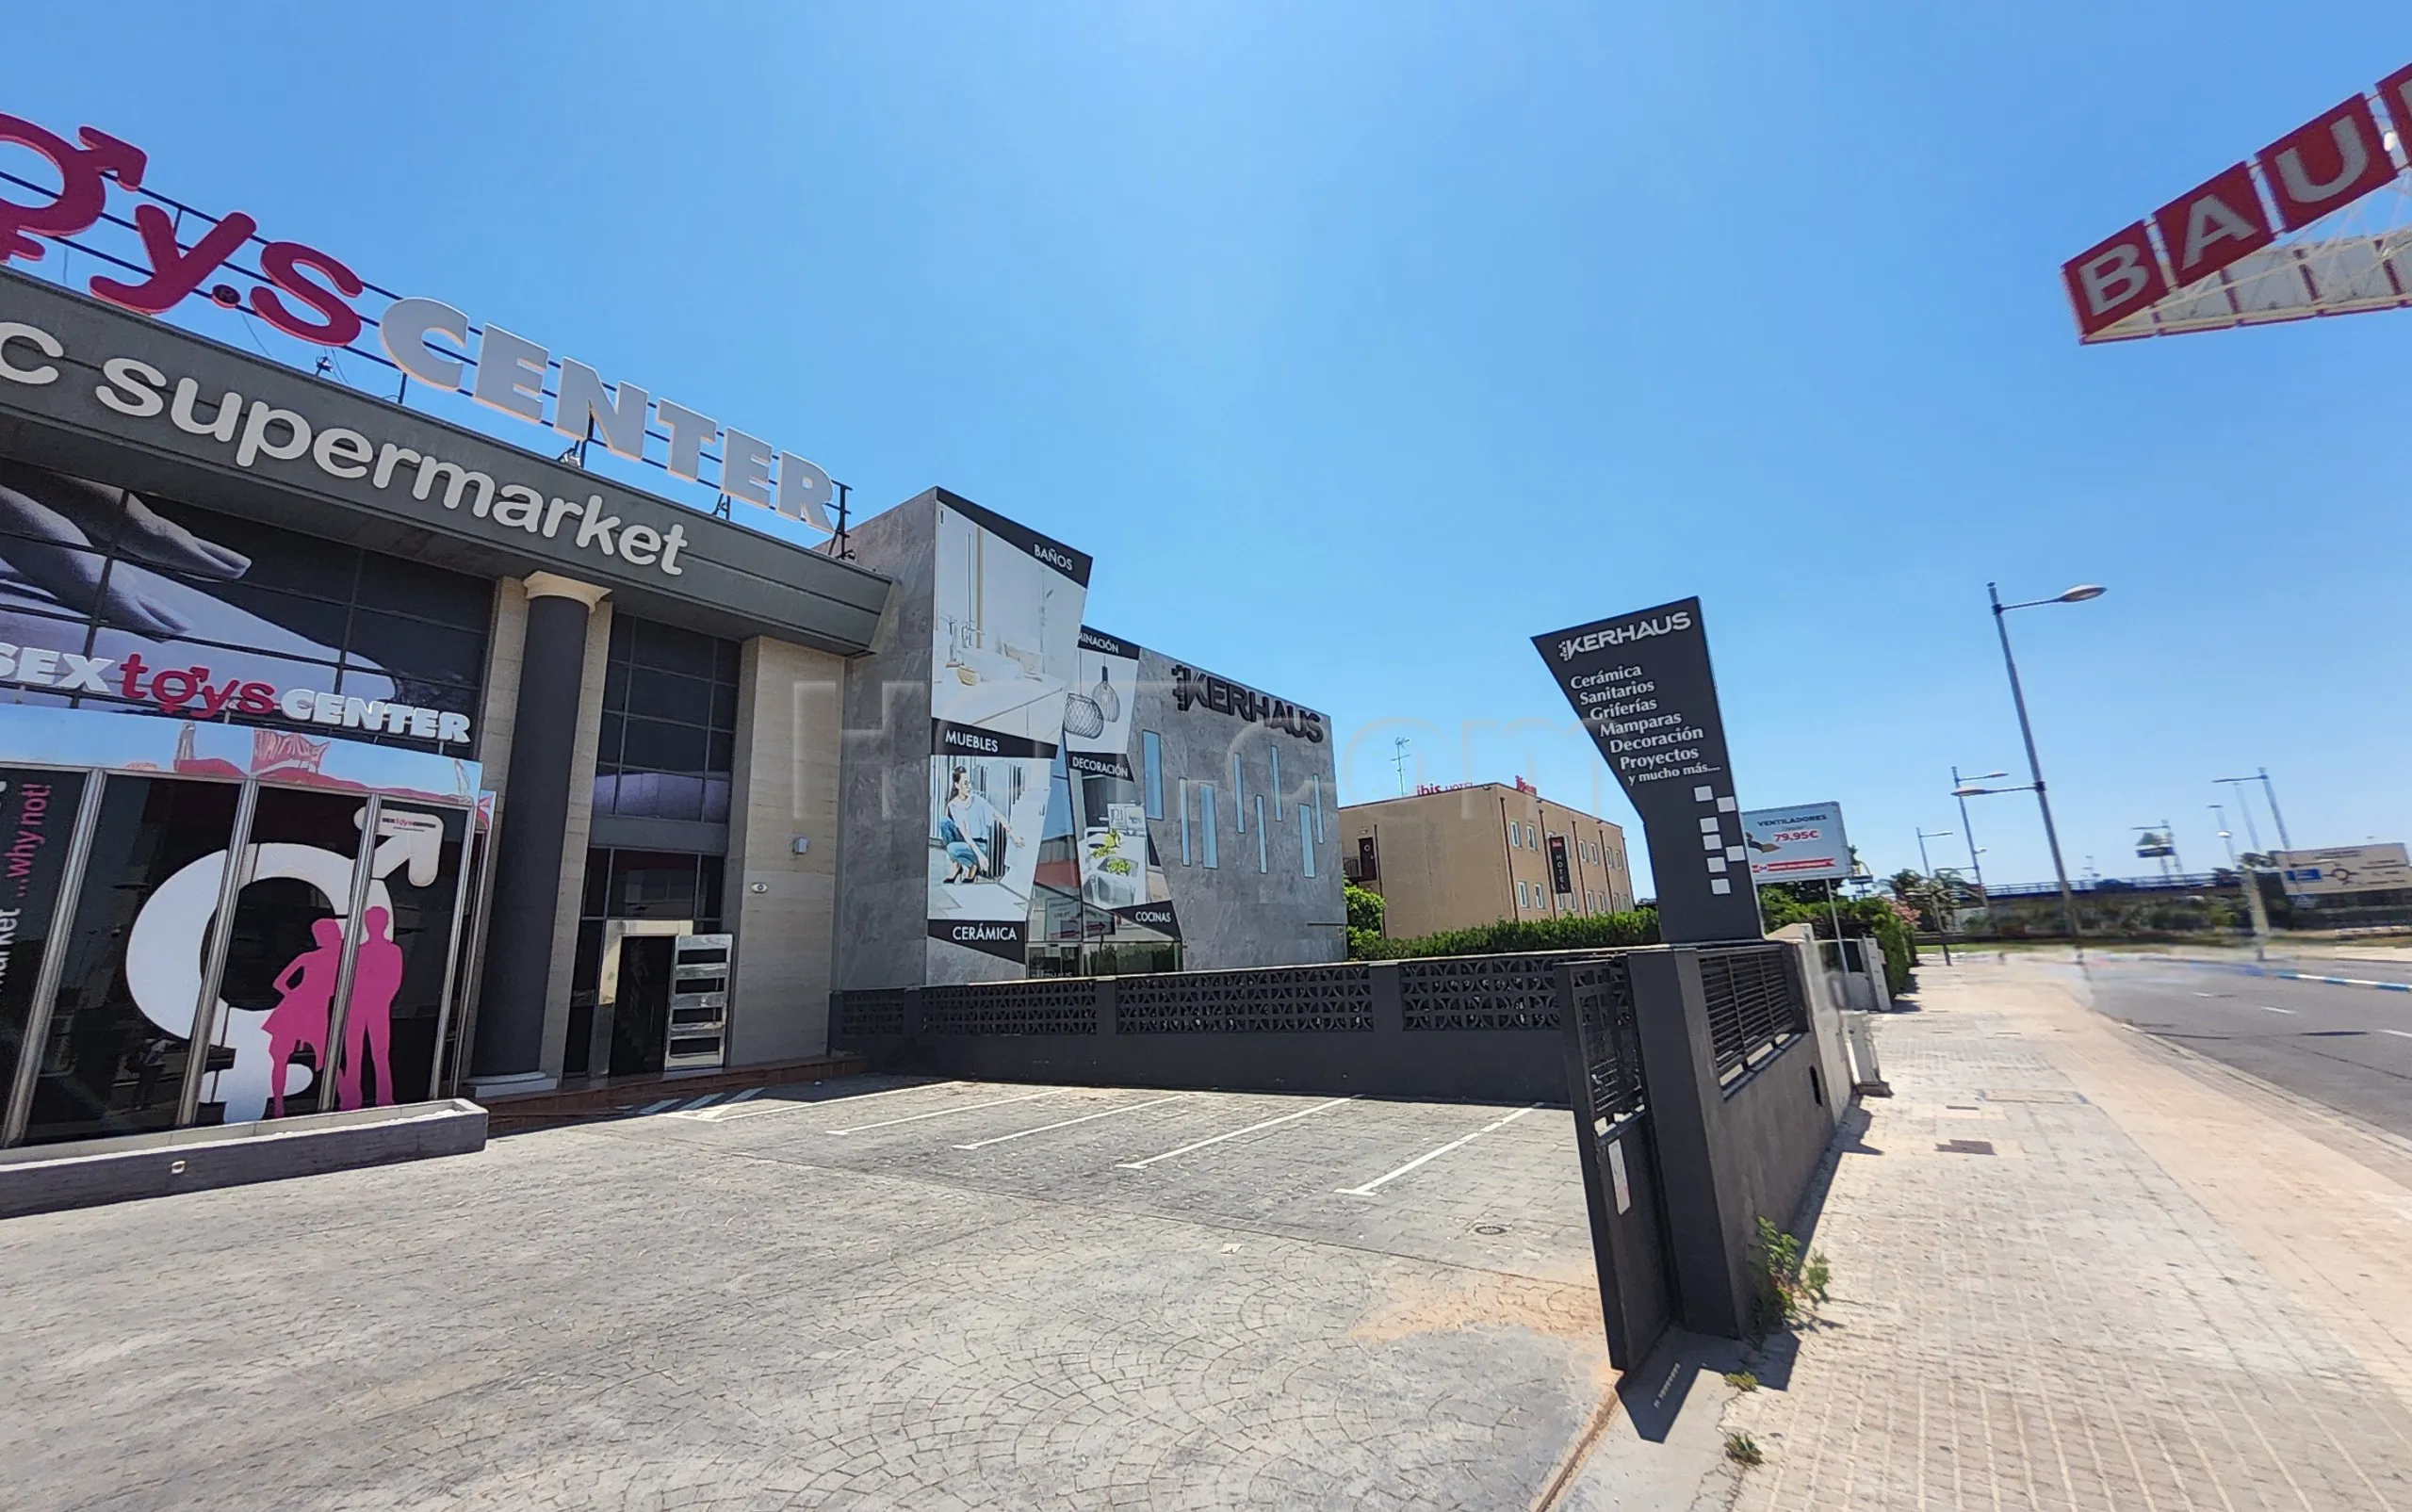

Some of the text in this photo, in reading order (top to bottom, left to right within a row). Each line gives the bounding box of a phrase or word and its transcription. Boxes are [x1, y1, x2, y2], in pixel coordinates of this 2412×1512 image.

[2079, 77, 2412, 317] BAU
[95, 357, 689, 576] supermarket
[1033, 544, 1074, 573] BAÑOS
[1562, 611, 1692, 660] KERHAUS
[1570, 665, 1642, 690] Cerámica
[1180, 664, 1325, 744] KERHAUS
[1579, 679, 1655, 706] Sanitarios
[281, 689, 471, 743] CENTER
[1589, 697, 1658, 722] Griferías
[1600, 712, 1683, 738] Mamparas
[945, 731, 999, 754] MUEBLES
[1609, 725, 1704, 754] Decoración
[1072, 756, 1129, 778] DECORACIÓN
[1620, 747, 1700, 771] Proyectos
[1628, 774, 1637, 786] y
[1638, 767, 1681, 783] mucho
[20, 783, 53, 825] not!
[1757, 814, 1828, 827] VENTILADORES
[1135, 911, 1172, 924] COCINAS
[952, 922, 1018, 942] CERÁMICA
